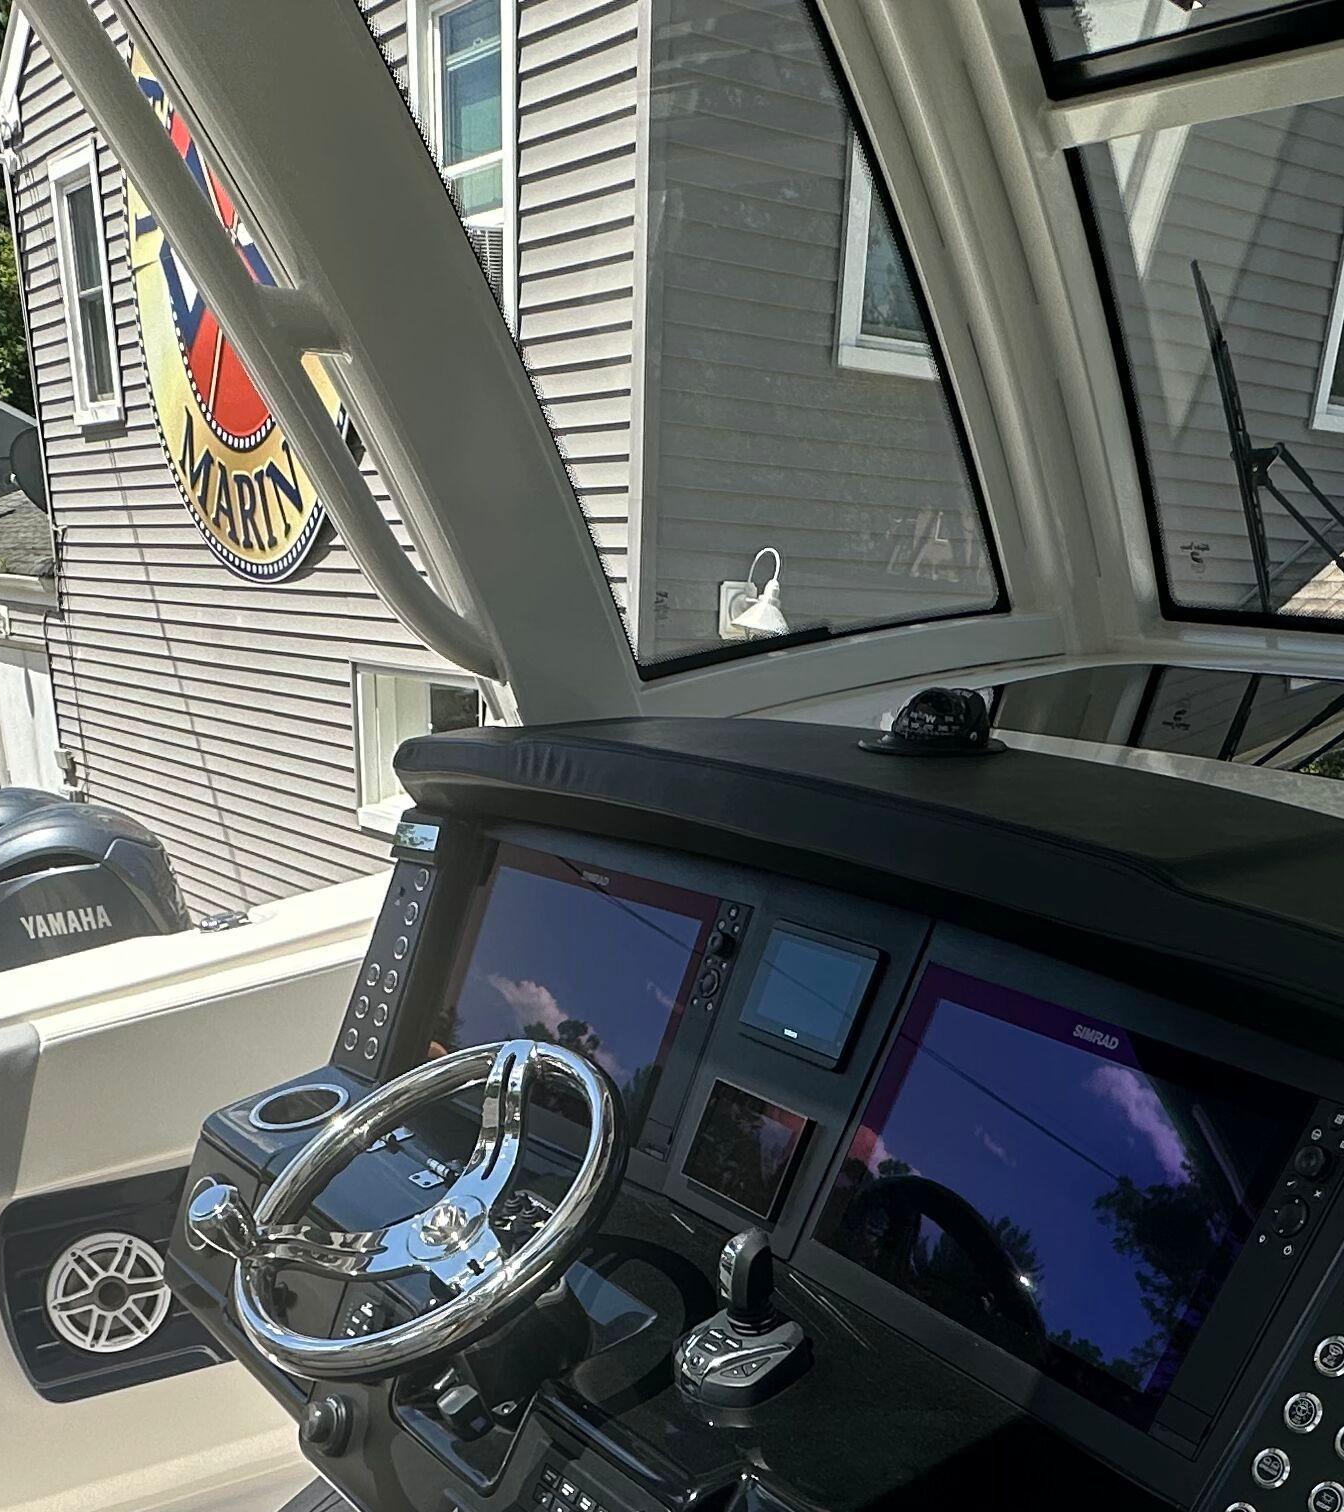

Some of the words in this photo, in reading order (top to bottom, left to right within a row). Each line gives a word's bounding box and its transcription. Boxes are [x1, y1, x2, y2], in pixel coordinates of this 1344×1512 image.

[179, 406, 303, 552] MARIN
[19, 904, 112, 940] YAMAHA
[1072, 1024, 1119, 1050] SIMRAD
